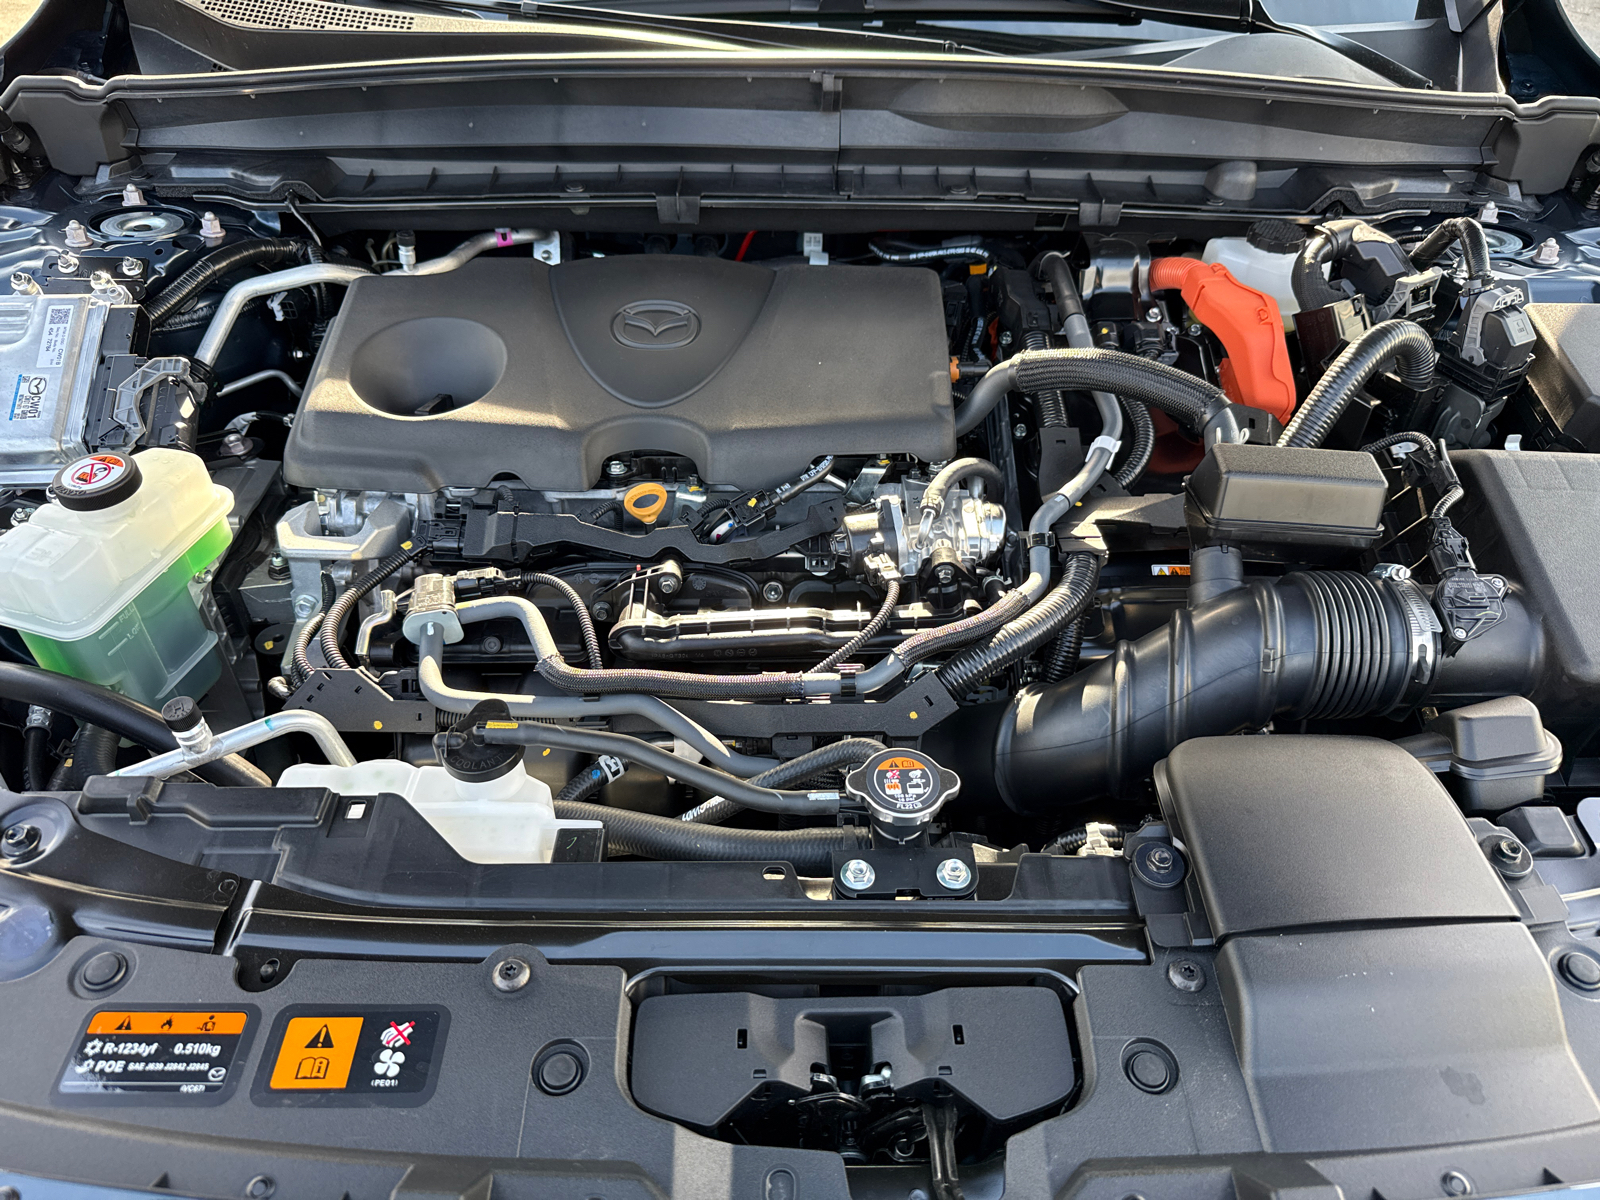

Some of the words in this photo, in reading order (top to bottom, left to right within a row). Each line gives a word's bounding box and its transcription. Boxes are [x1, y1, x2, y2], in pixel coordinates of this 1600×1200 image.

[27, 395, 42, 419] CW01
[118, 604, 135, 623] FULL
[450, 753, 503, 770] COOLANT
[103, 1042, 158, 1057] R-1234yf
[173, 1043, 222, 1057] 0.510kg
[95, 1060, 126, 1073] POE
[127, 1062, 146, 1071] SAE
[145, 1062, 164, 1071] J639
[370, 1079, 399, 1088] (PE01)
